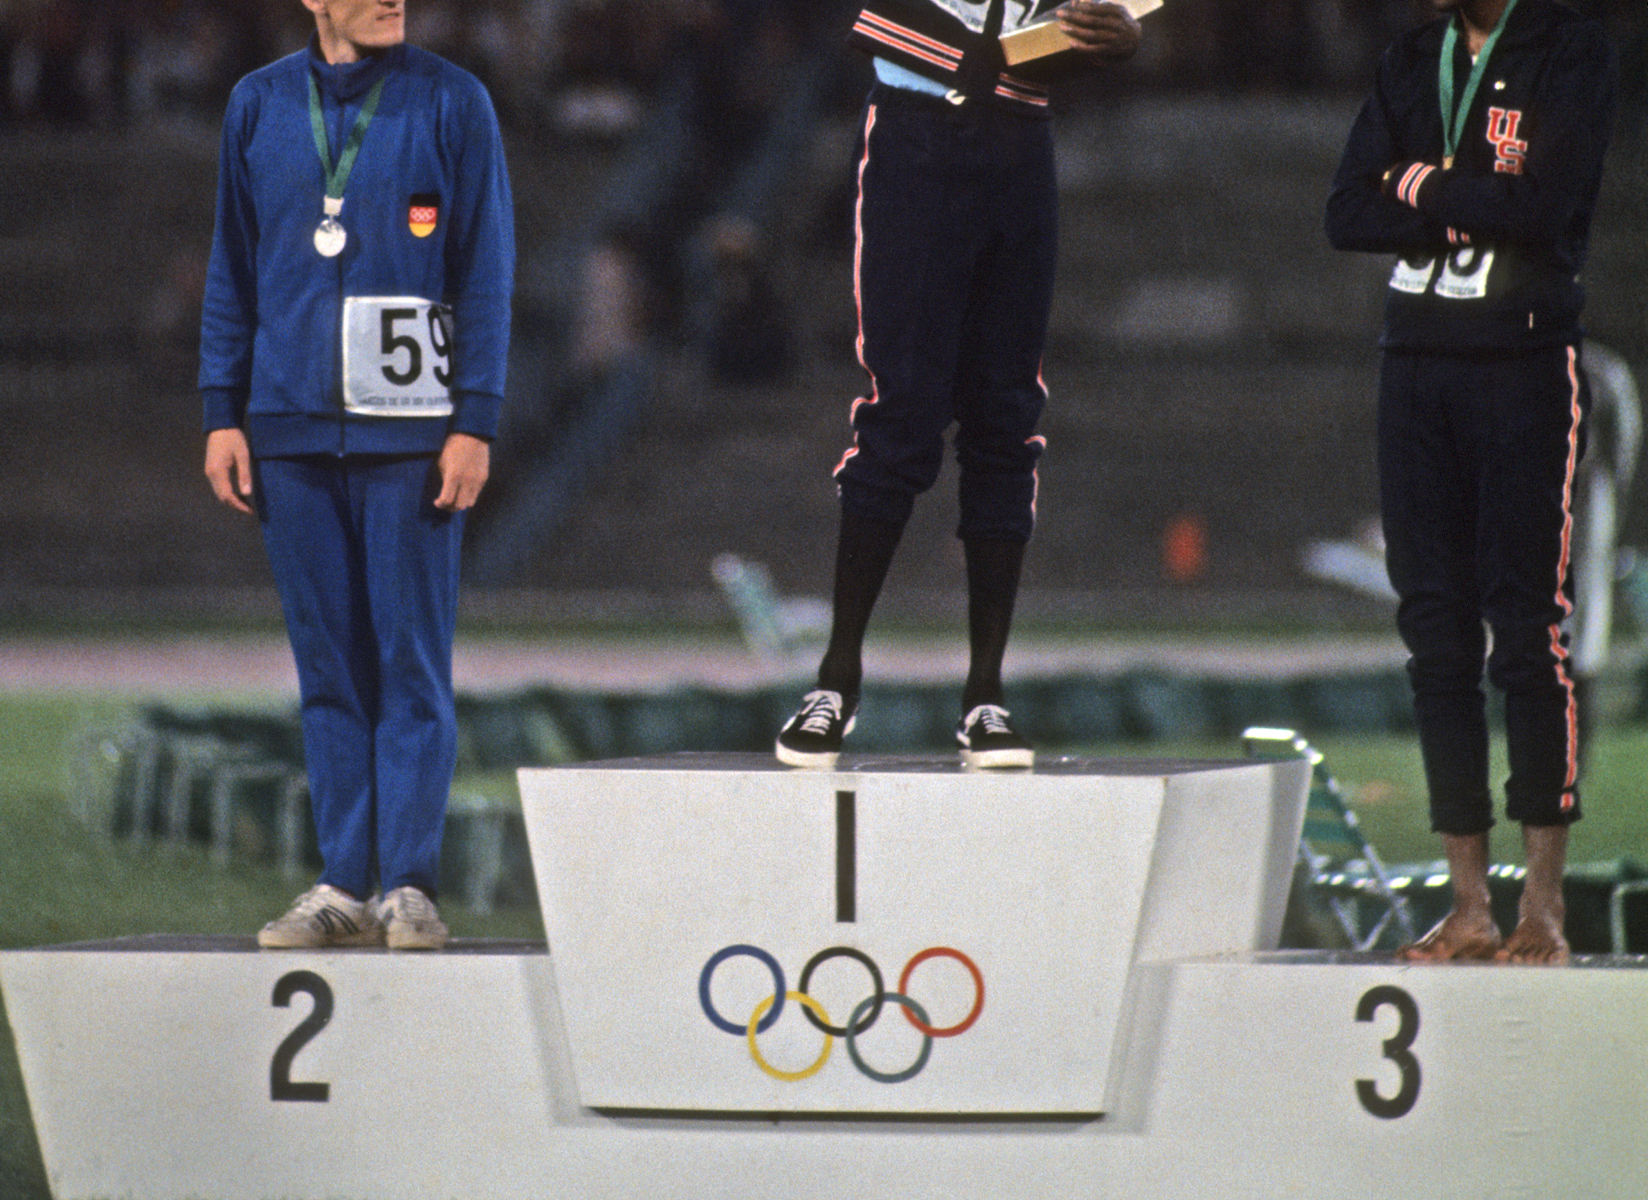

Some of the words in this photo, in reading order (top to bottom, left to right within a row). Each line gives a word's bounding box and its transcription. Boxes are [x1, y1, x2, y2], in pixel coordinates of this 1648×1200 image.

[381, 304, 453, 388] 59
[270, 970, 335, 1102] 2
[1355, 985, 1423, 1120] 3
